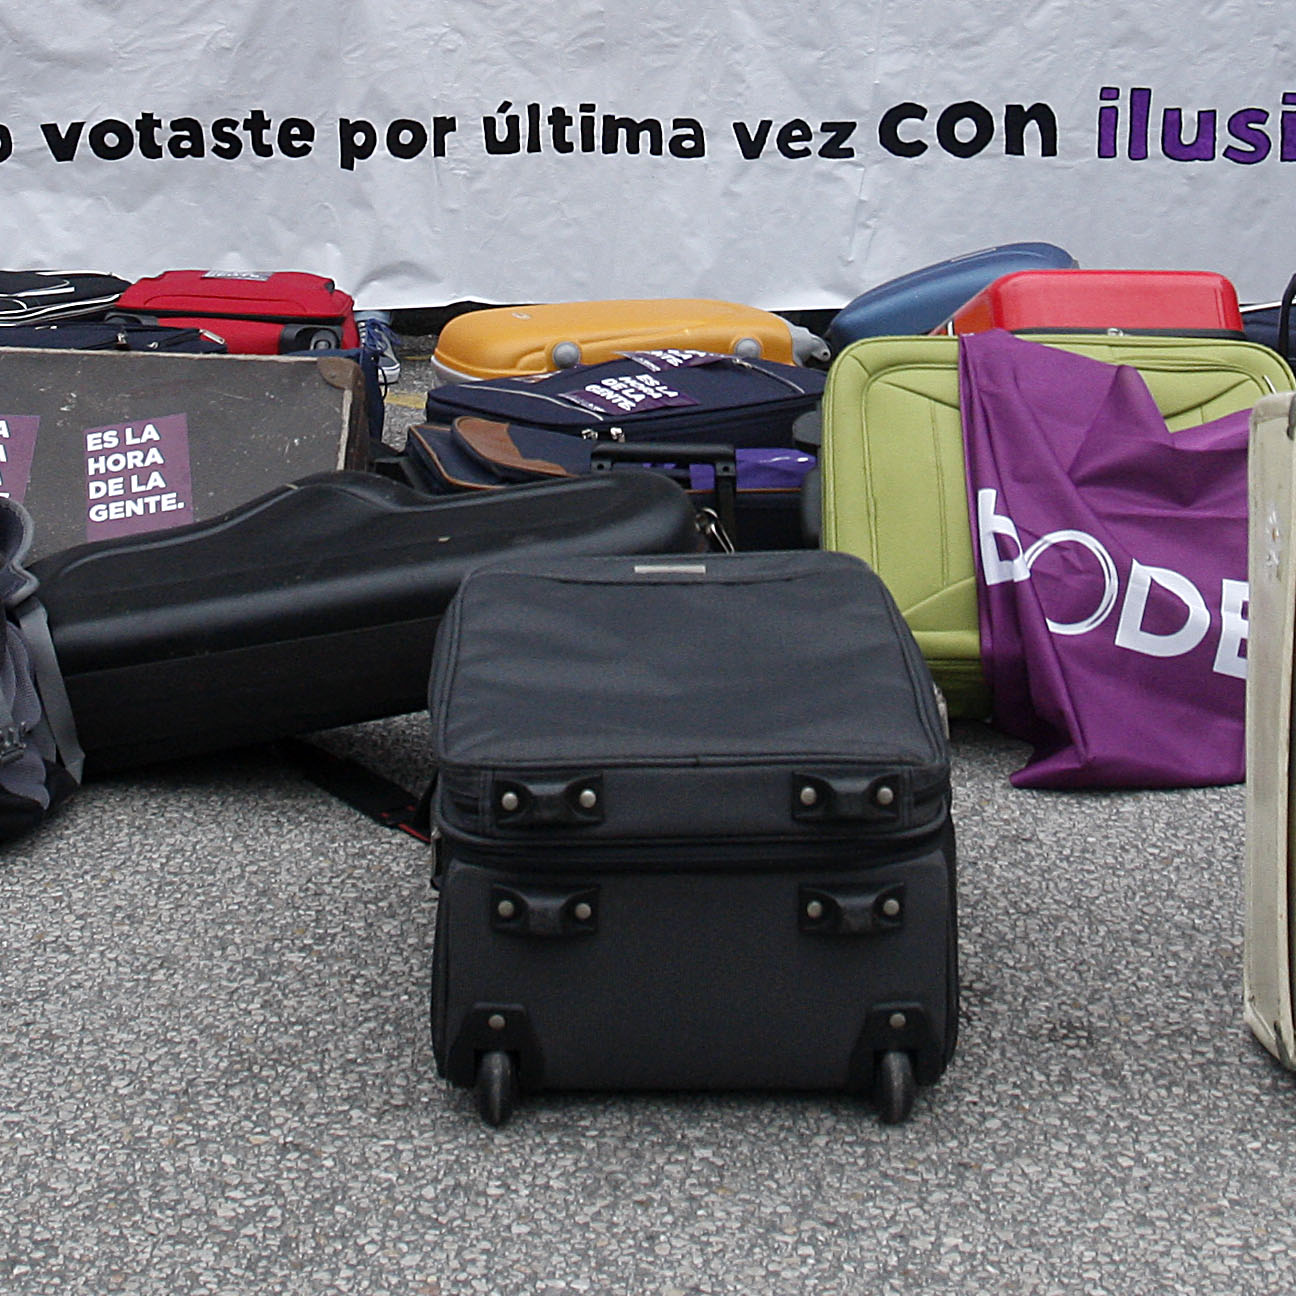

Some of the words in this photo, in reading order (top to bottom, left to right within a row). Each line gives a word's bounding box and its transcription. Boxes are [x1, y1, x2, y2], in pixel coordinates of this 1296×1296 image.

[40, 109, 315, 163] votaste
[338, 116, 457, 172] por
[482, 100, 706, 160] última
[732, 118, 858, 160] vez
[878, 100, 1058, 159] con
[600, 378, 629, 391] DE
[621, 388, 646, 403] LA
[86, 431, 119, 452] ES
[125, 423, 160, 444] LA
[87, 447, 164, 476] HORA
[89, 479, 124, 500] DE
[130, 471, 167, 492] LA
[89, 491, 185, 523] GENTE.
